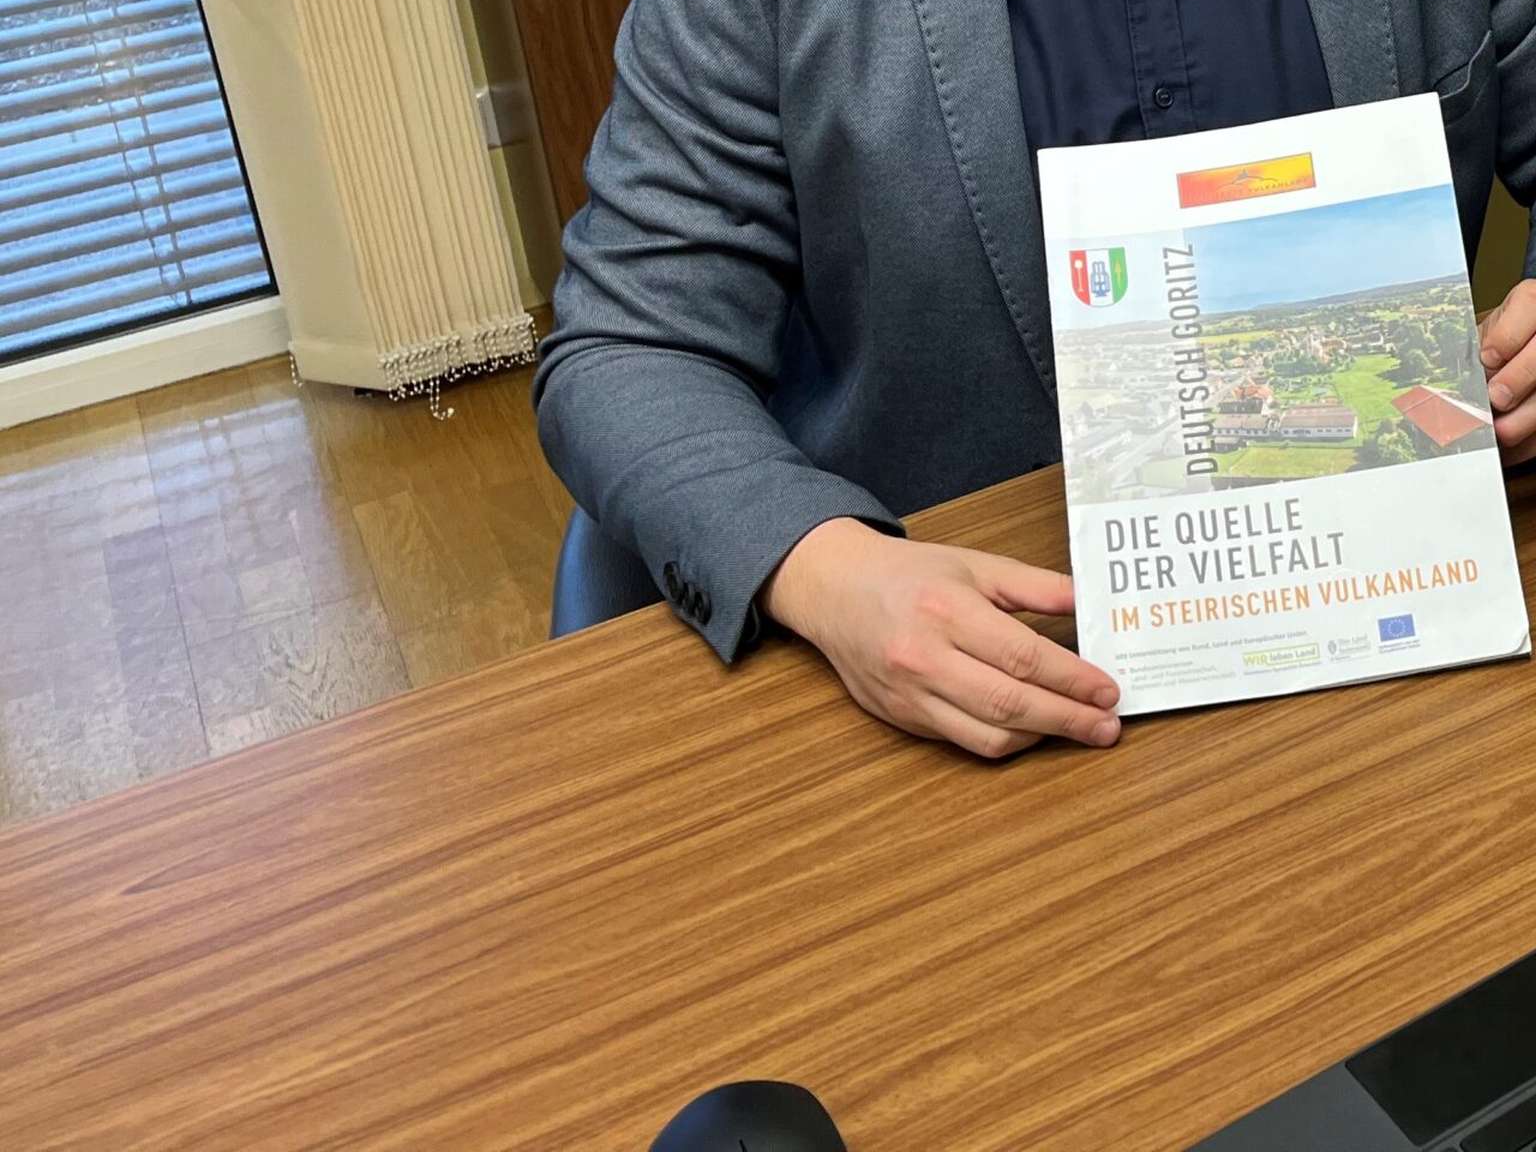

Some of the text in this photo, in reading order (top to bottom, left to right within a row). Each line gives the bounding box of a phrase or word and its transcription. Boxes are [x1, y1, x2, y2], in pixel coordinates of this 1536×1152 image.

[1162, 244, 1219, 476] DEUTSCH GORITZ
[1105, 498, 1303, 553] DIE QUELLE
[1109, 532, 1345, 594] DER VIELFALT
[1111, 558, 1479, 633] IM STEIRISCHEN VULKANLAND
[1243, 654, 1268, 668] WIR
[1295, 648, 1316, 660] Land
